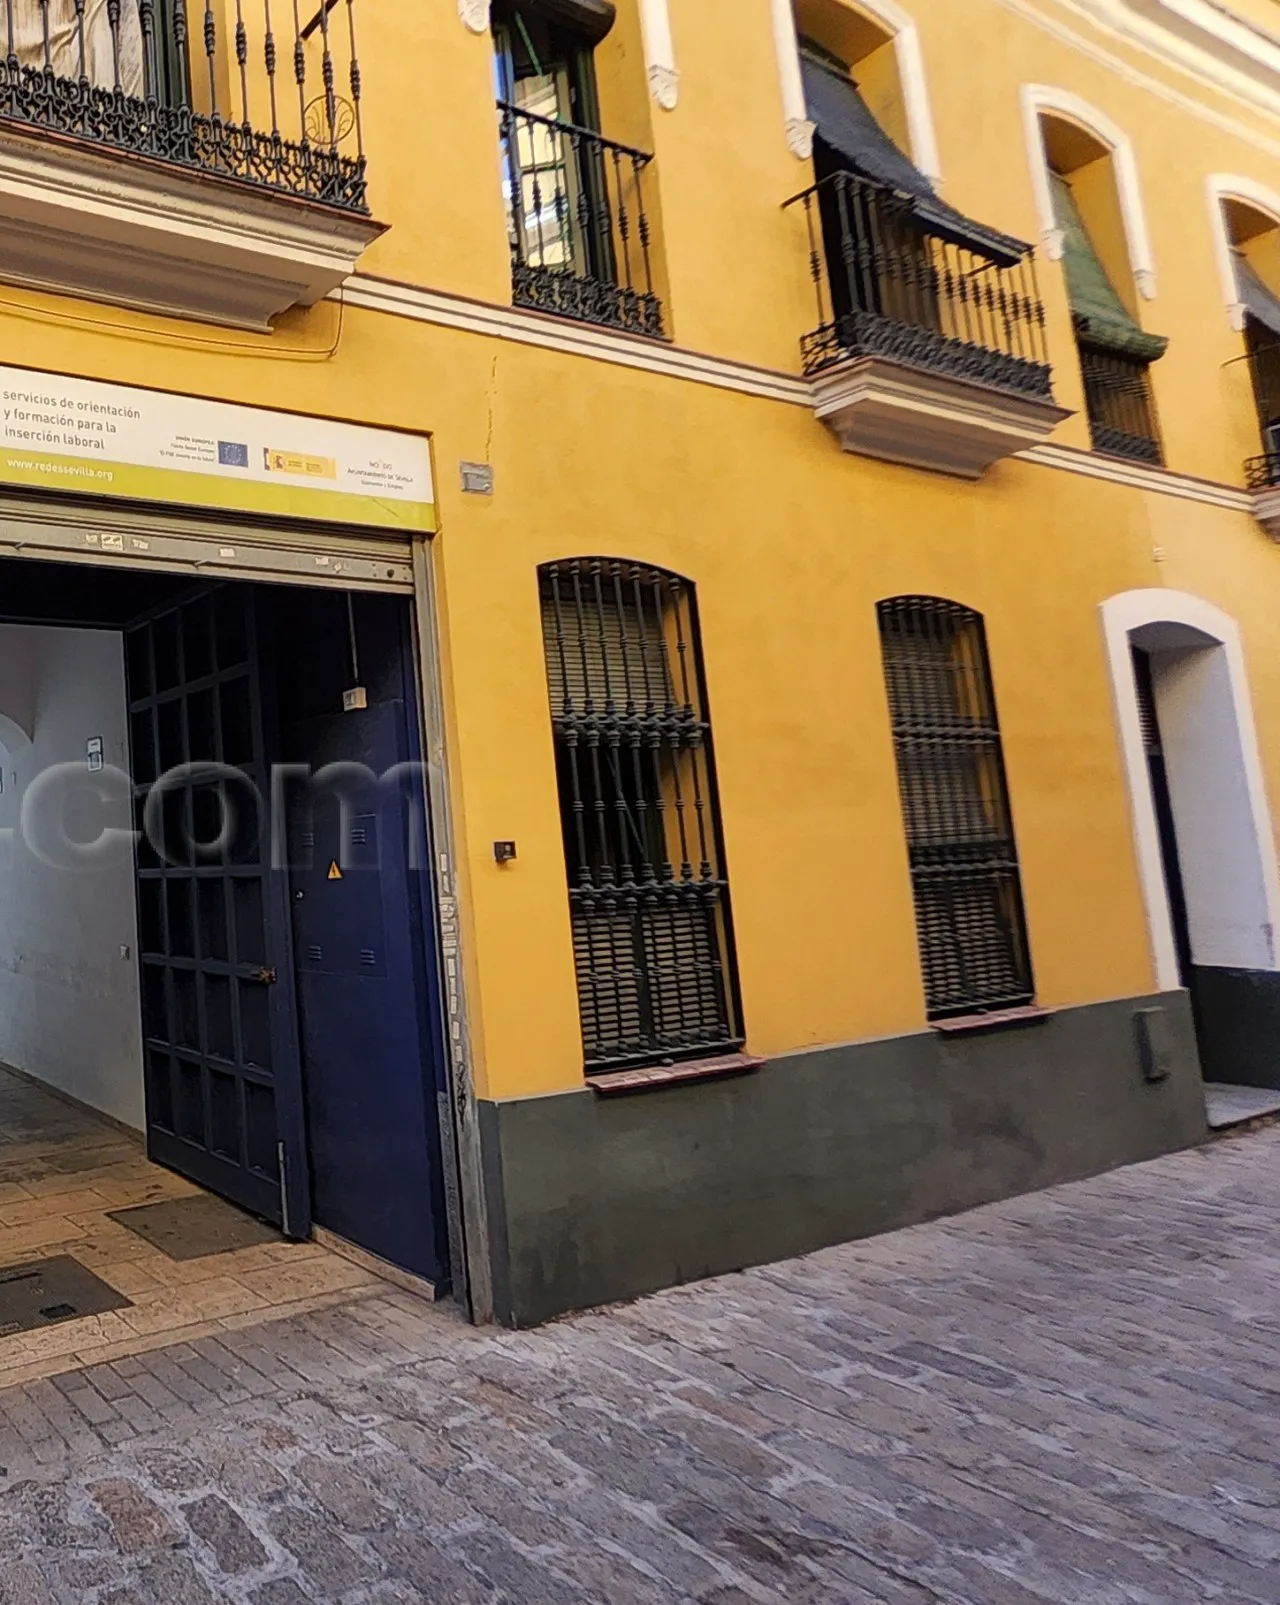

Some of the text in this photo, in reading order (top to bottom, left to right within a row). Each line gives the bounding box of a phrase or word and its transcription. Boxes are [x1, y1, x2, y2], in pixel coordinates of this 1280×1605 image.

[3, 390, 141, 419] servicios de orientación
[3, 408, 117, 433] y formación para la
[4, 425, 105, 449] inserción laboral
[7, 459, 114, 481] www.redessevilla.org
